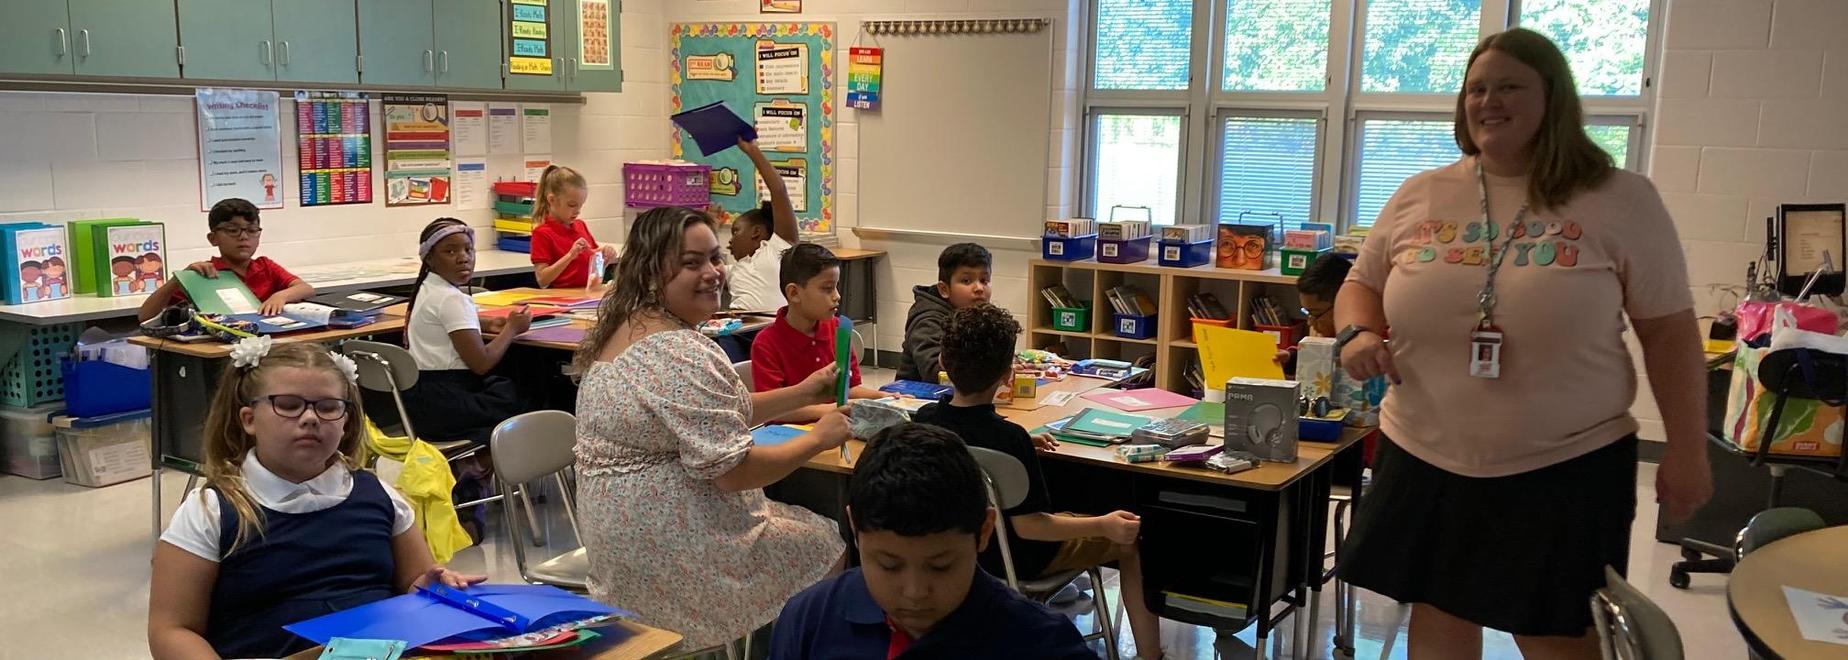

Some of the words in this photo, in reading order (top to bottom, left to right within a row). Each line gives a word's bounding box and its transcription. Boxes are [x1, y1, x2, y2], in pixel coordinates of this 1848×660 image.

[854, 73, 873, 82] EVERY
[857, 82, 869, 91] DAY
[854, 100, 870, 109] LISTEN
[1463, 221, 1499, 243] SO
[21, 243, 62, 258] words
[113, 239, 159, 253] words
[1514, 239, 1578, 267] YOU
